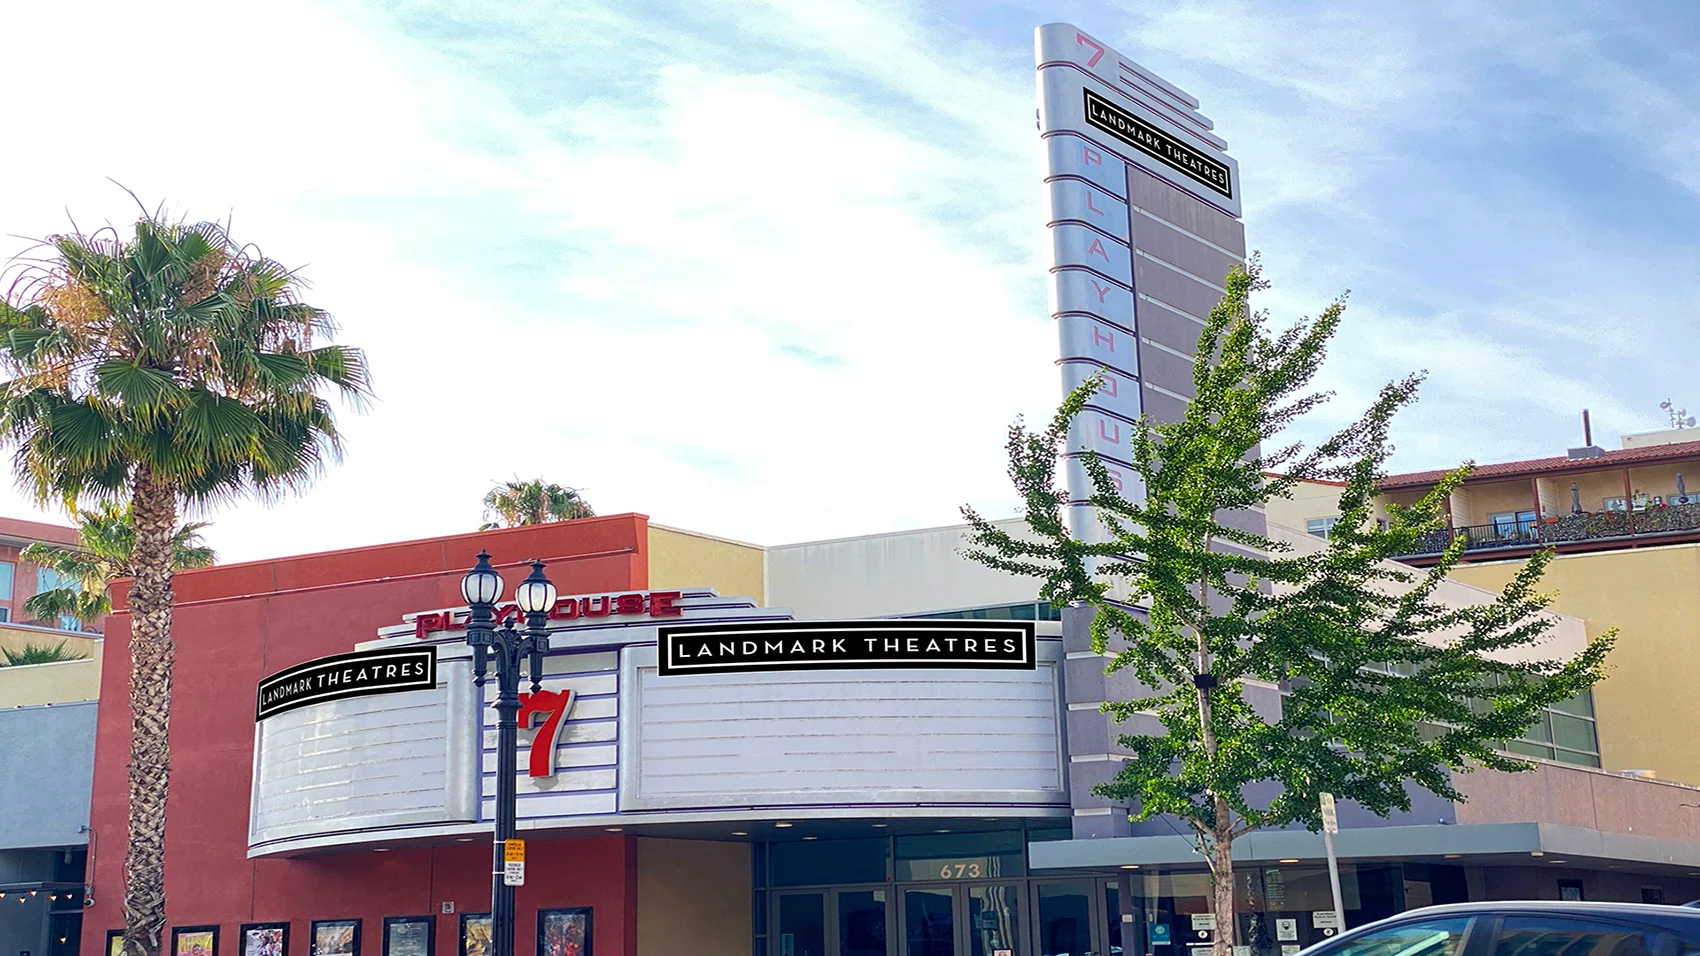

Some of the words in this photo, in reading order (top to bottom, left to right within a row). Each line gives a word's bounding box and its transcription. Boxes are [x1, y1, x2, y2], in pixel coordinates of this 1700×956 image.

[1076, 33, 1105, 68] 7
[1092, 104, 1161, 150] LANDMARK
[1166, 144, 1225, 184] THEATRES
[679, 638, 847, 658] LANDMARK
[864, 638, 1016, 653] THEATRES
[262, 677, 313, 706] LANDMARK
[317, 662, 424, 688] THEATRES
[518, 688, 575, 777] 7
[940, 864, 981, 879] 673
